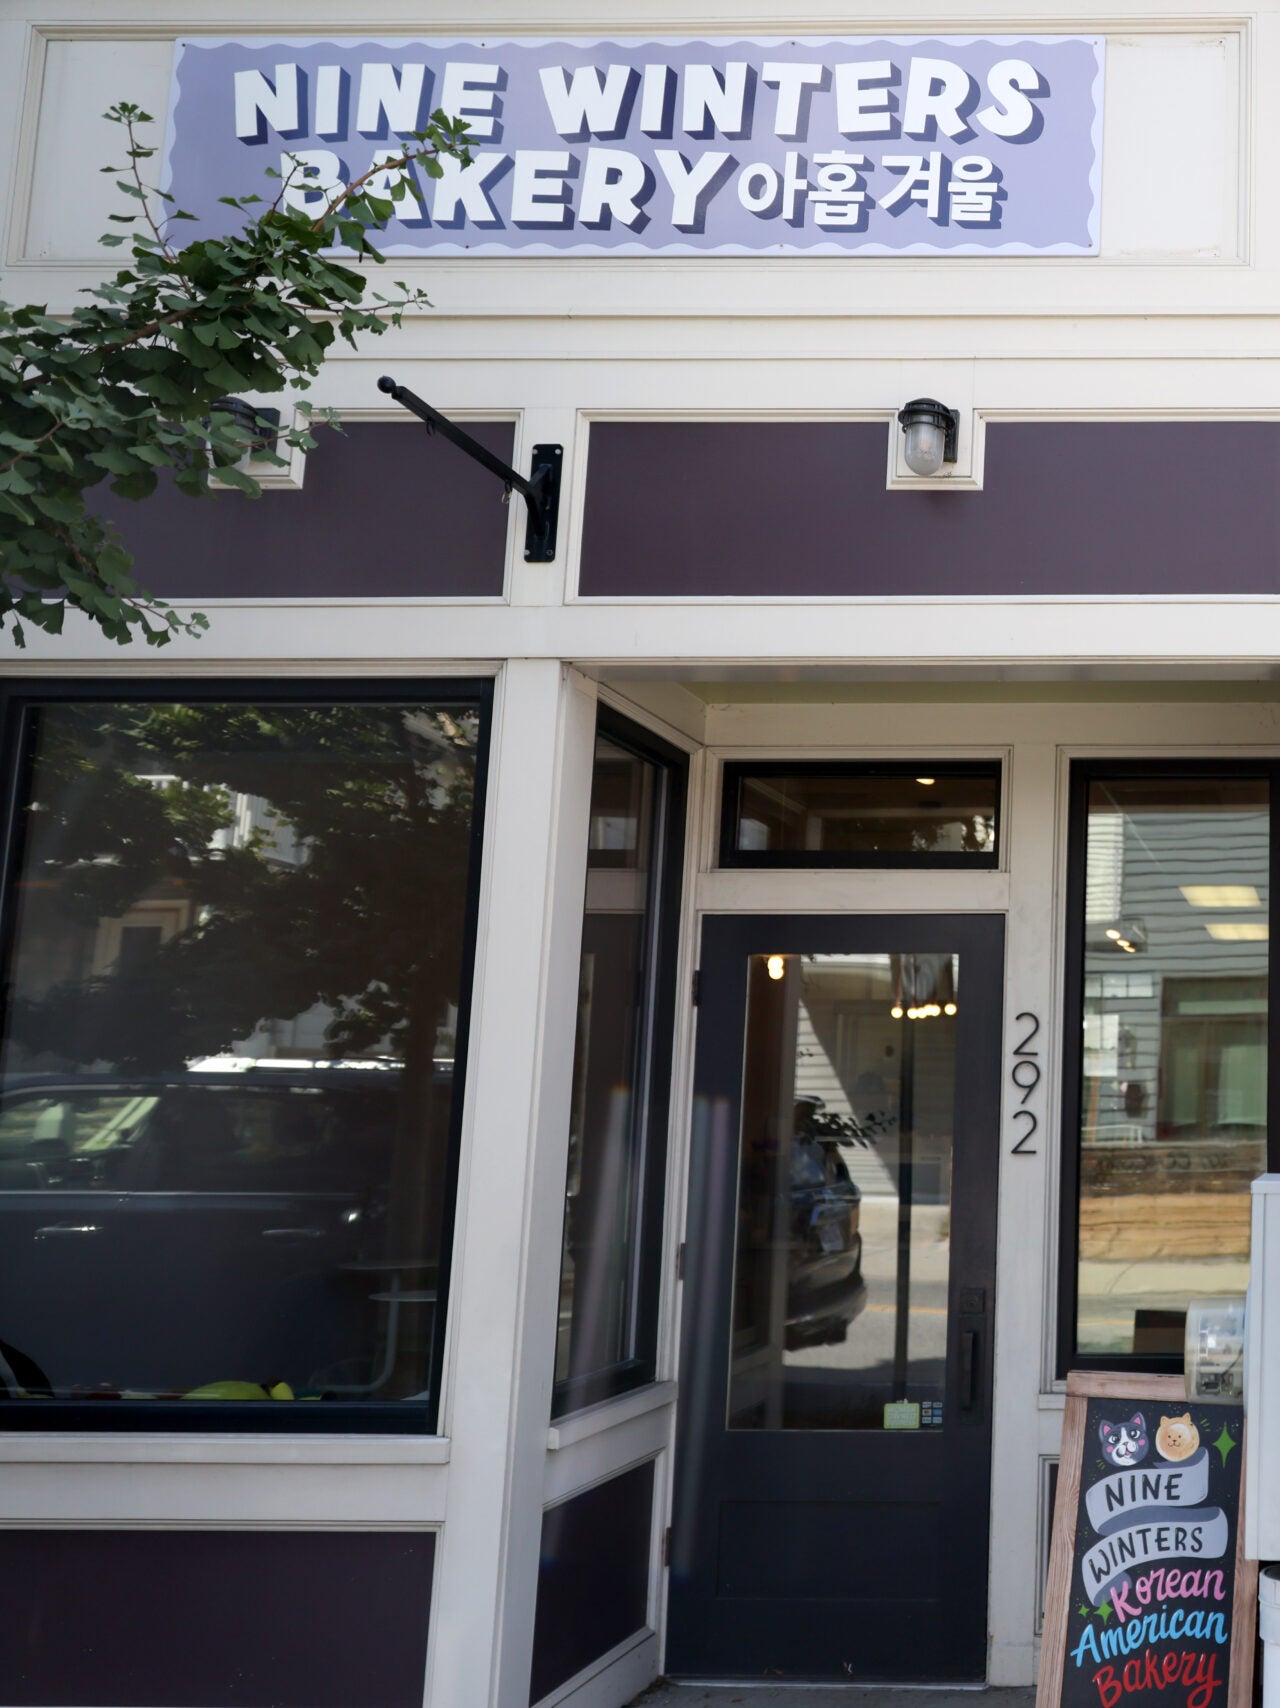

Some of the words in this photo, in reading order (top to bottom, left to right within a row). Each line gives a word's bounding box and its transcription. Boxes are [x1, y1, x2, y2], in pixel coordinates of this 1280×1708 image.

[234, 62, 507, 144] NINE
[538, 57, 1047, 144] WINTERS
[280, 148, 736, 232] BAKERY
[738, 150, 873, 230] 아홉
[878, 151, 1006, 228] 겨울
[1011, 1012, 1041, 1155] 292
[1105, 1473, 1183, 1512] NINE
[1089, 1527, 1203, 1584] WINTERS
[1110, 1568, 1226, 1623] Korean
[1070, 1604, 1228, 1667] American
[1093, 1648, 1223, 1708] Bakery
